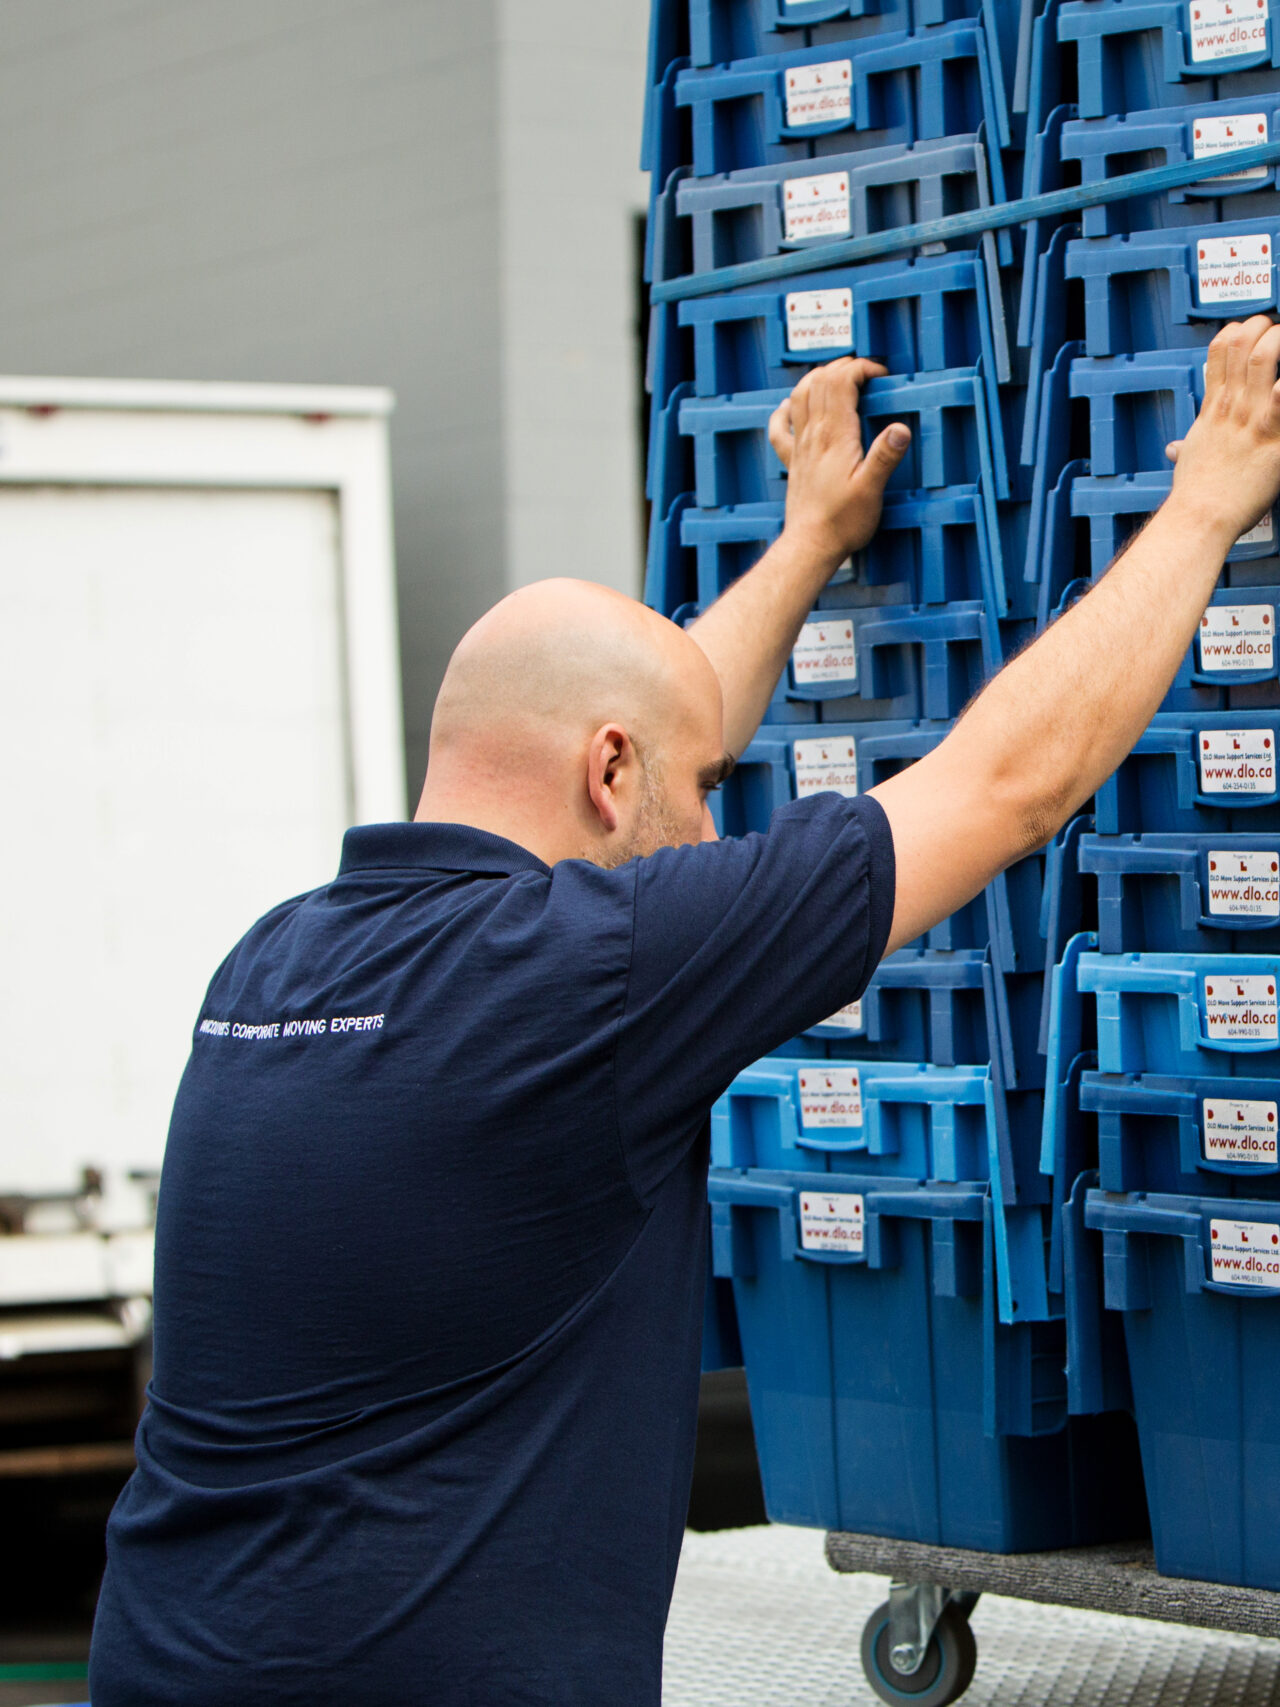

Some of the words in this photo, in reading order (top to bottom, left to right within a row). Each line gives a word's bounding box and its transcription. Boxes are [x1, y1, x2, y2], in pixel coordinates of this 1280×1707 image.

[1225, 4, 1232, 15] L
[1196, 26, 1265, 49] www.dlo.ca
[1226, 126, 1233, 136] L
[1230, 246, 1236, 257] L
[1201, 271, 1269, 287] www.dlo.ca
[1232, 615, 1239, 626] L
[1204, 640, 1270, 655] www.dlo.ca
[1233, 738, 1240, 749] L
[1227, 754, 1243, 762] Support
[1245, 752, 1262, 760] Services
[1205, 763, 1272, 778] www.dlo.ca
[1240, 861, 1247, 872] L
[1234, 876, 1250, 884] Support
[1212, 886, 1278, 901] www.dlo.ca
[1237, 984, 1244, 995] L
[1209, 1009, 1276, 1024] www.dlo.ca
[232, 1022, 280, 1040] CORPORATE
[283, 1019, 326, 1037] MOVING
[330, 1014, 385, 1033] EXPERTS
[1237, 1110, 1244, 1121] L
[1231, 1125, 1247, 1133] Support
[1209, 1135, 1275, 1151] www.dlo.ca
[1241, 1231, 1248, 1242] L
[1235, 1245, 1251, 1254] Support
[1214, 1256, 1279, 1273] www.dlo.ca
